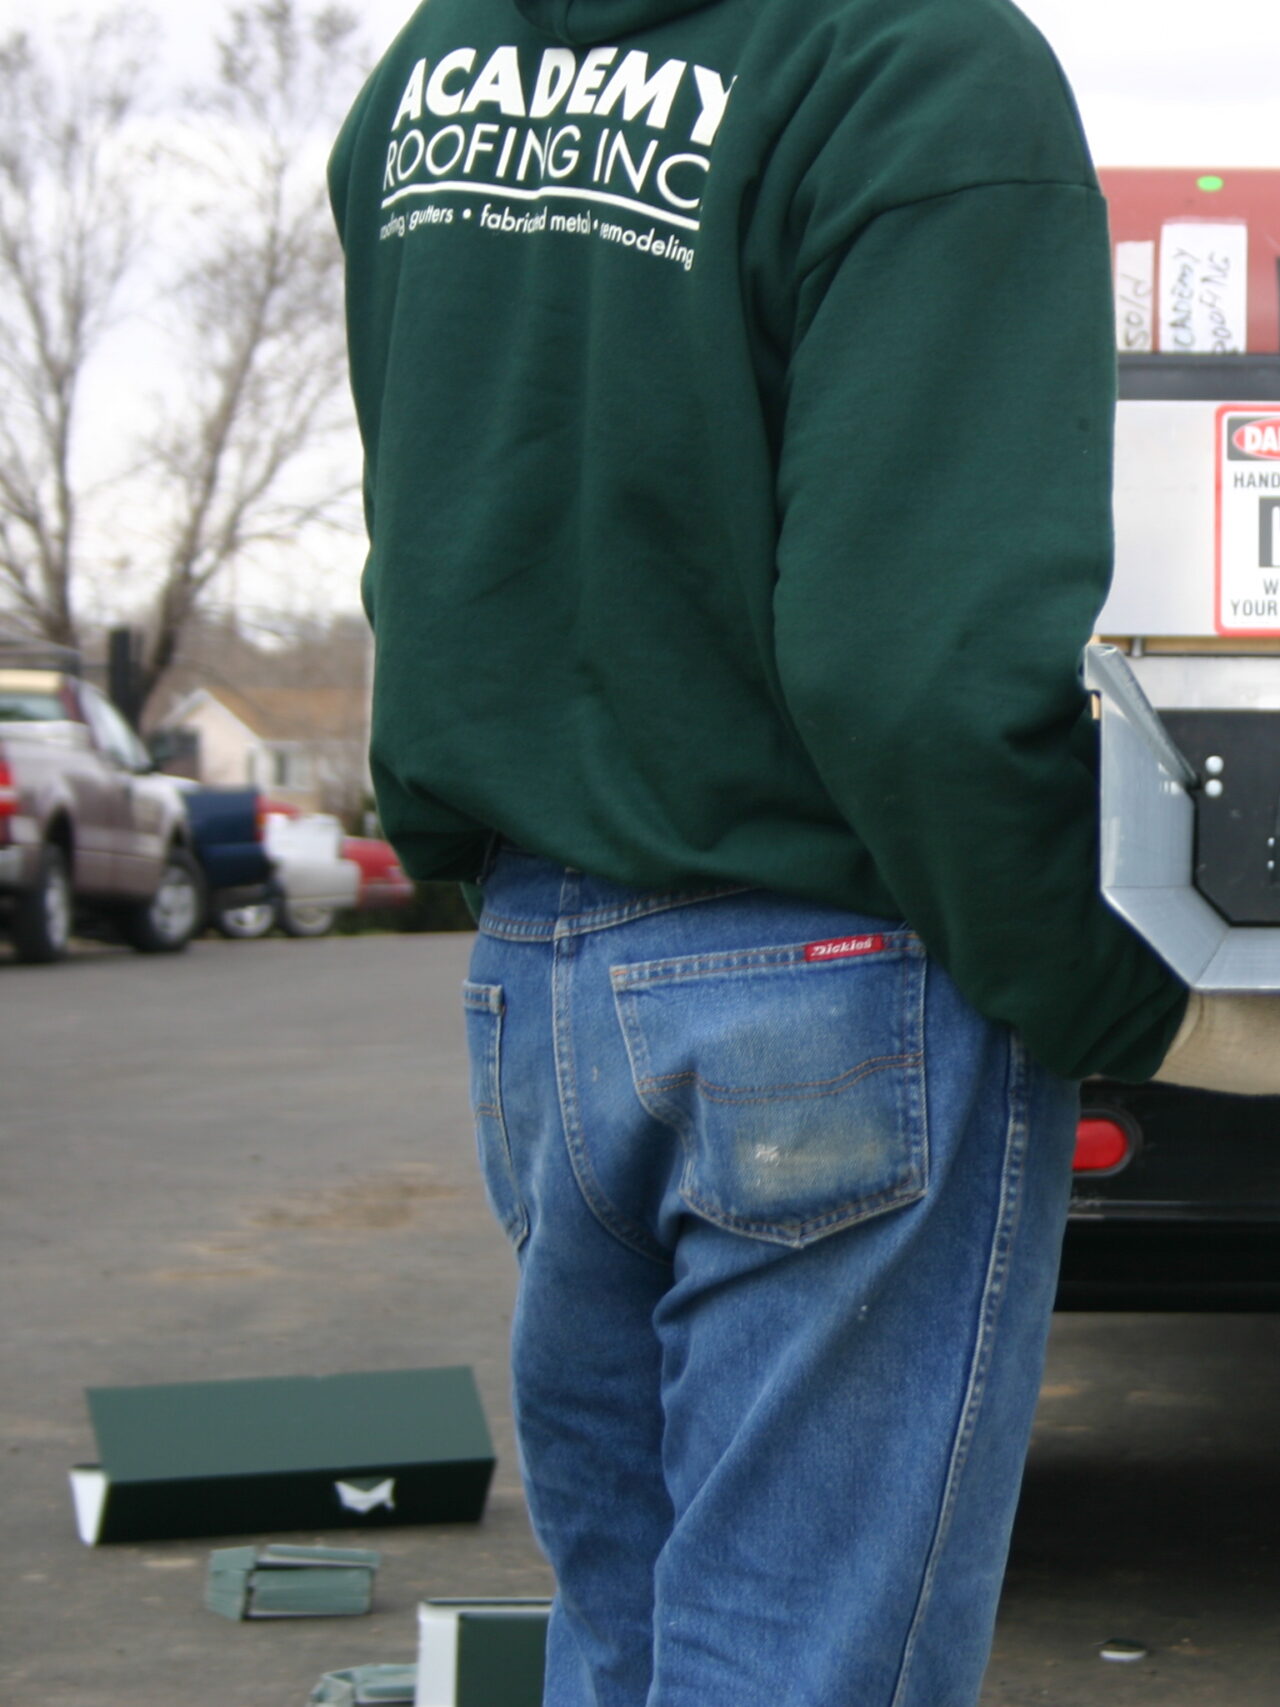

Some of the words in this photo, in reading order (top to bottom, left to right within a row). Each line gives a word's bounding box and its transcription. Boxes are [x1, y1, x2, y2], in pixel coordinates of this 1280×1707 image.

[391, 45, 738, 146] ACADEMY
[383, 123, 582, 192] ROOFING
[593, 128, 711, 209] INC
[408, 204, 454, 231] gutters
[480, 203, 547, 233] fabricd
[550, 210, 591, 237] metal
[599, 221, 695, 271] remodeling
[1234, 472, 1280, 488] HAND
[1230, 599, 1277, 616] YOUR
[810, 936, 874, 957] Dickies
